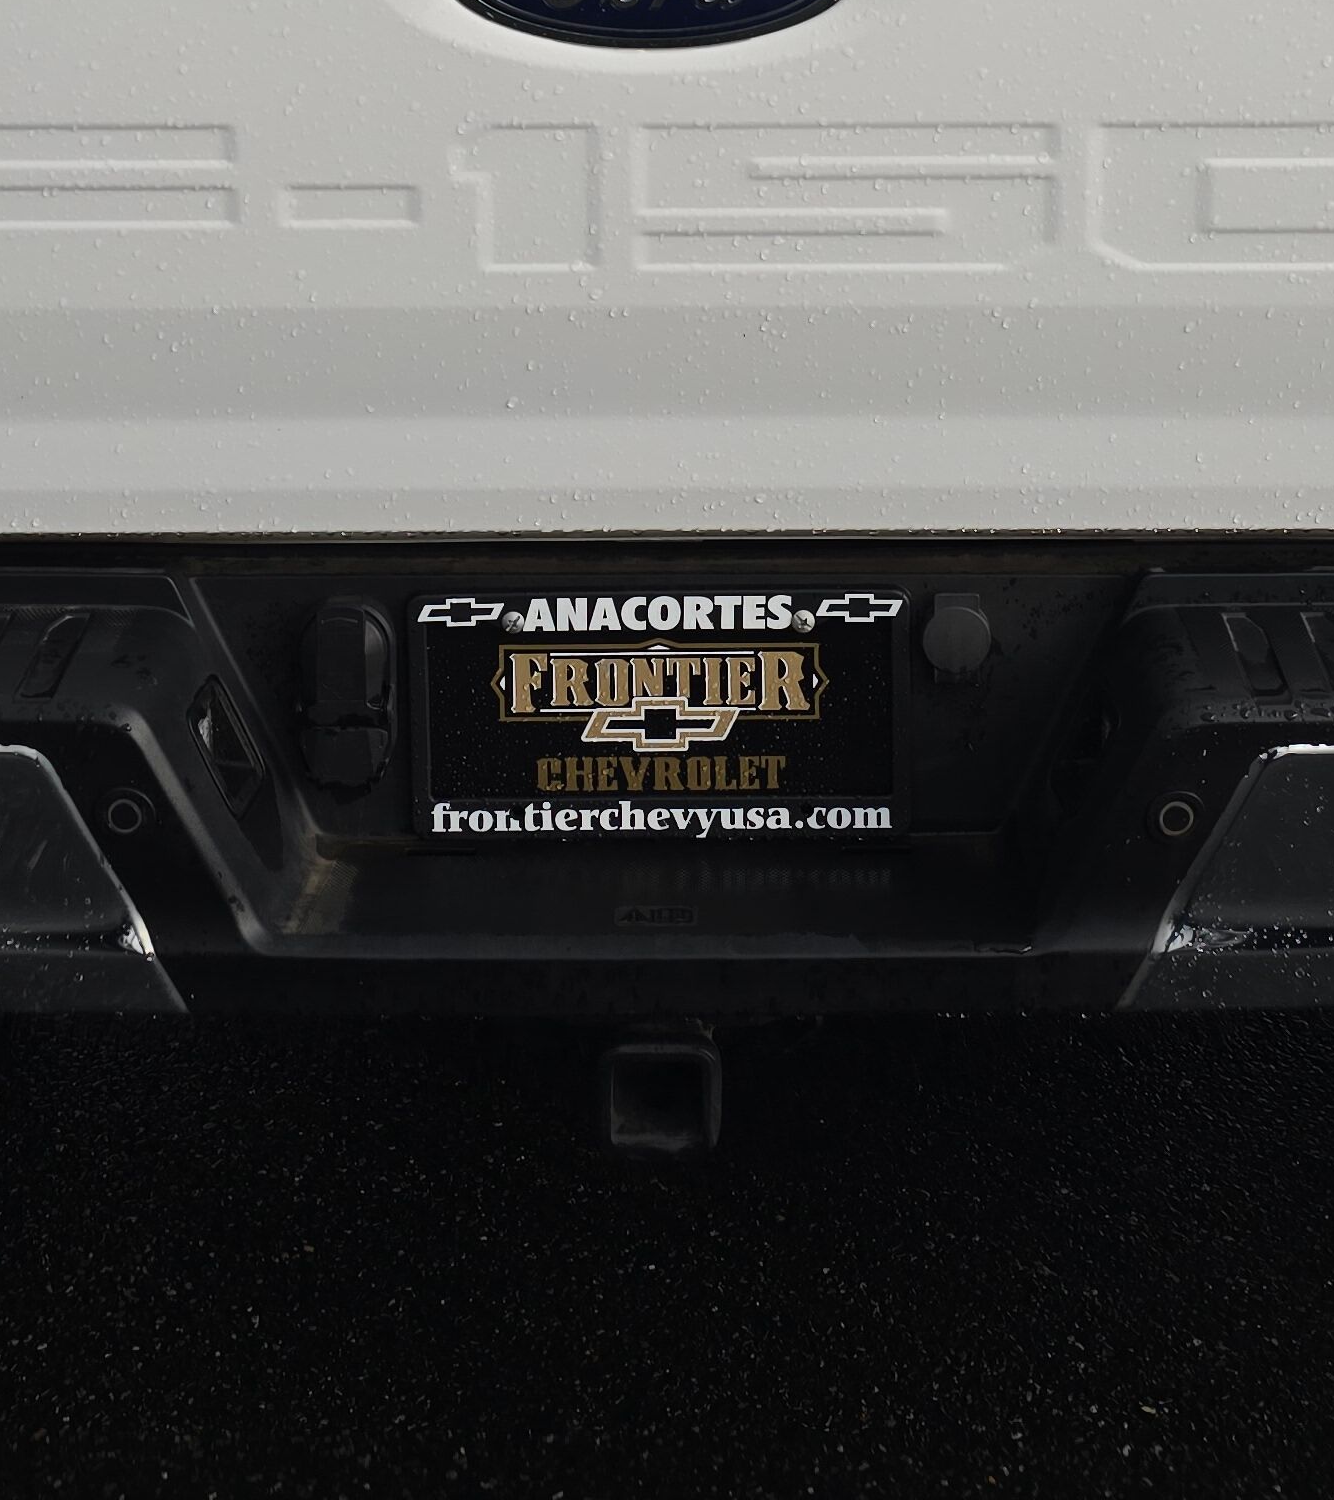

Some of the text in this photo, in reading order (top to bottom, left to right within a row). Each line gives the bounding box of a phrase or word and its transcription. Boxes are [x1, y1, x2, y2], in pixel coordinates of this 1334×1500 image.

[522, 594, 793, 633] ANACORTES
[508, 649, 812, 714] FRONTIER
[535, 755, 786, 793] CHEVROLET
[430, 801, 893, 839] frontierchevyusa.com
